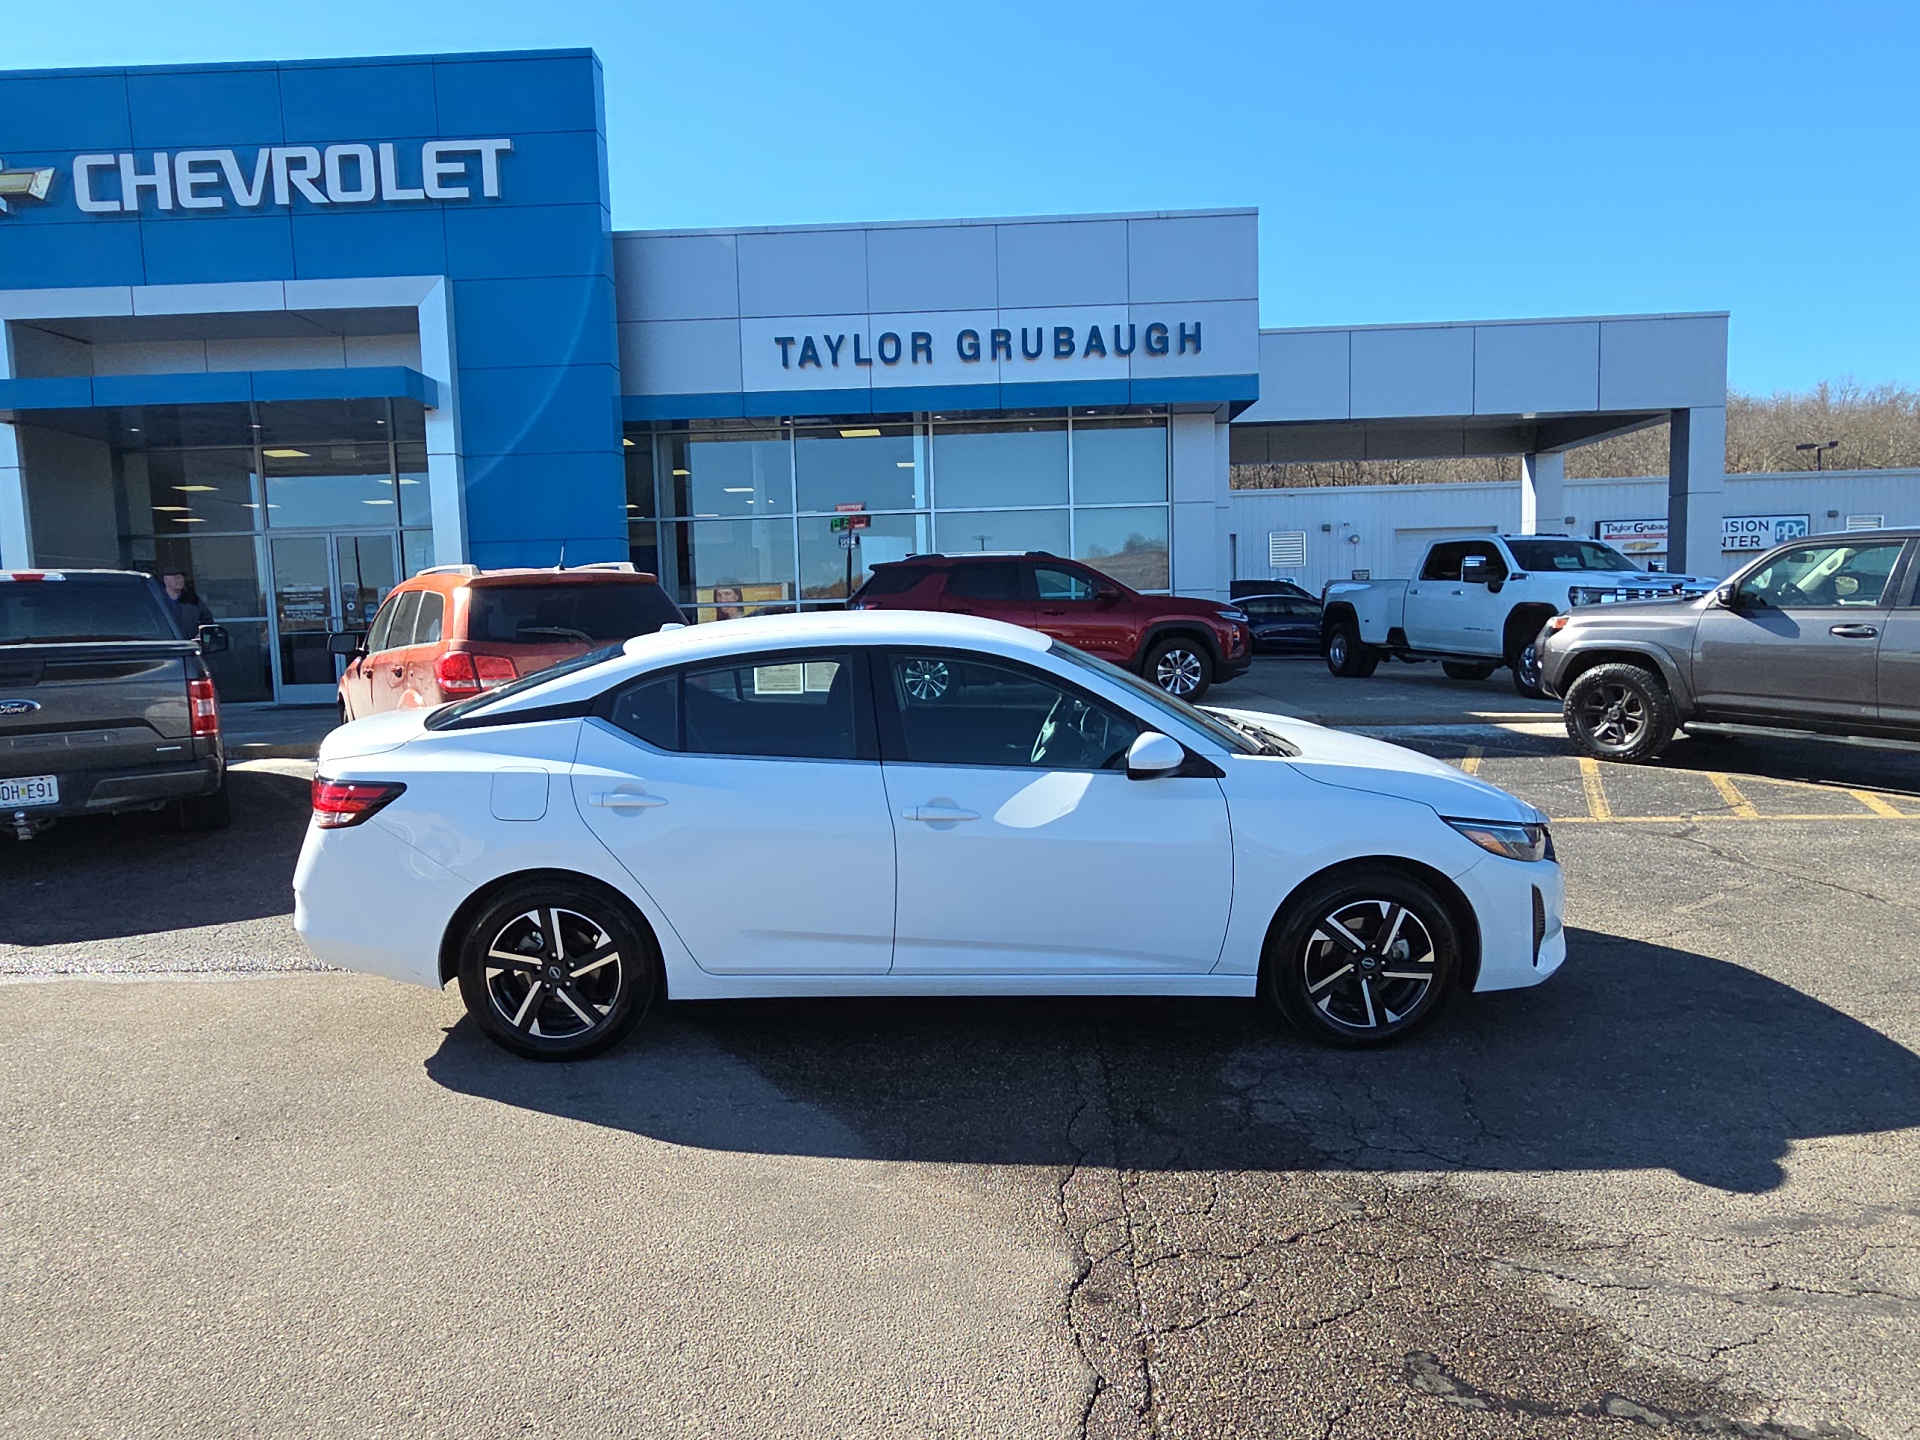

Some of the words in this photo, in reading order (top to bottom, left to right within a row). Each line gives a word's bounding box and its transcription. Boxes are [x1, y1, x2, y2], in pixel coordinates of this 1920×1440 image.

[73, 138, 511, 213] CHEVROLET
[774, 331, 933, 368] TAYLOR
[956, 321, 1202, 362] GRUBAUGH
[1604, 523, 1632, 533] Taylor
[1721, 520, 1769, 533] ISION
[0, 703, 28, 714] Ford
[0, 785, 20, 800] DH
[27, 782, 53, 798] E91
